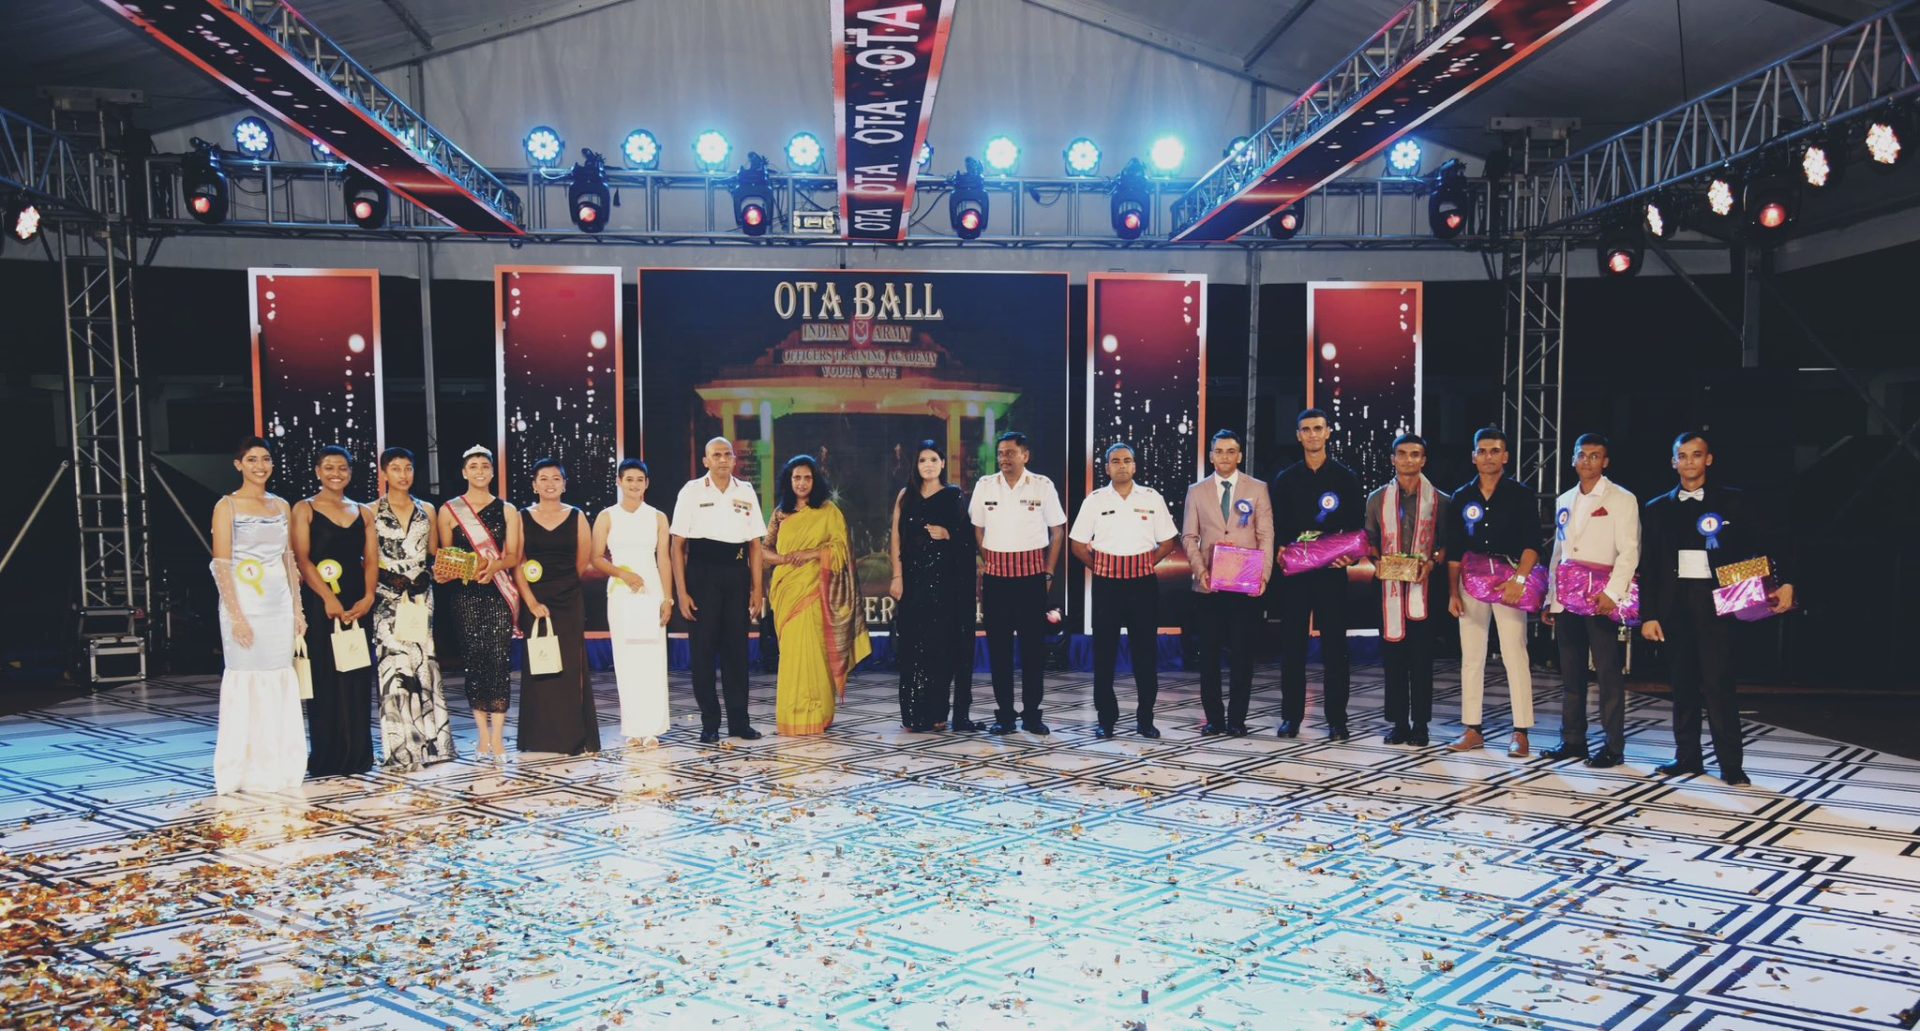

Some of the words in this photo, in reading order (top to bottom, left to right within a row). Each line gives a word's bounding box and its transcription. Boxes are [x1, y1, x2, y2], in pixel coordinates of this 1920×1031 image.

[855, 3, 923, 71] OTA
[854, 100, 909, 144] OTA
[854, 163, 899, 194] OTA
[854, 208, 893, 232] OTA
[774, 281, 845, 320] OTA
[853, 281, 944, 321] BALL
[801, 323, 850, 342] INDIAN
[872, 324, 912, 343] ARMY
[782, 349, 833, 366] OFFICERS
[834, 349, 886, 366] TRAINING
[887, 350, 939, 368] ACADEMY
